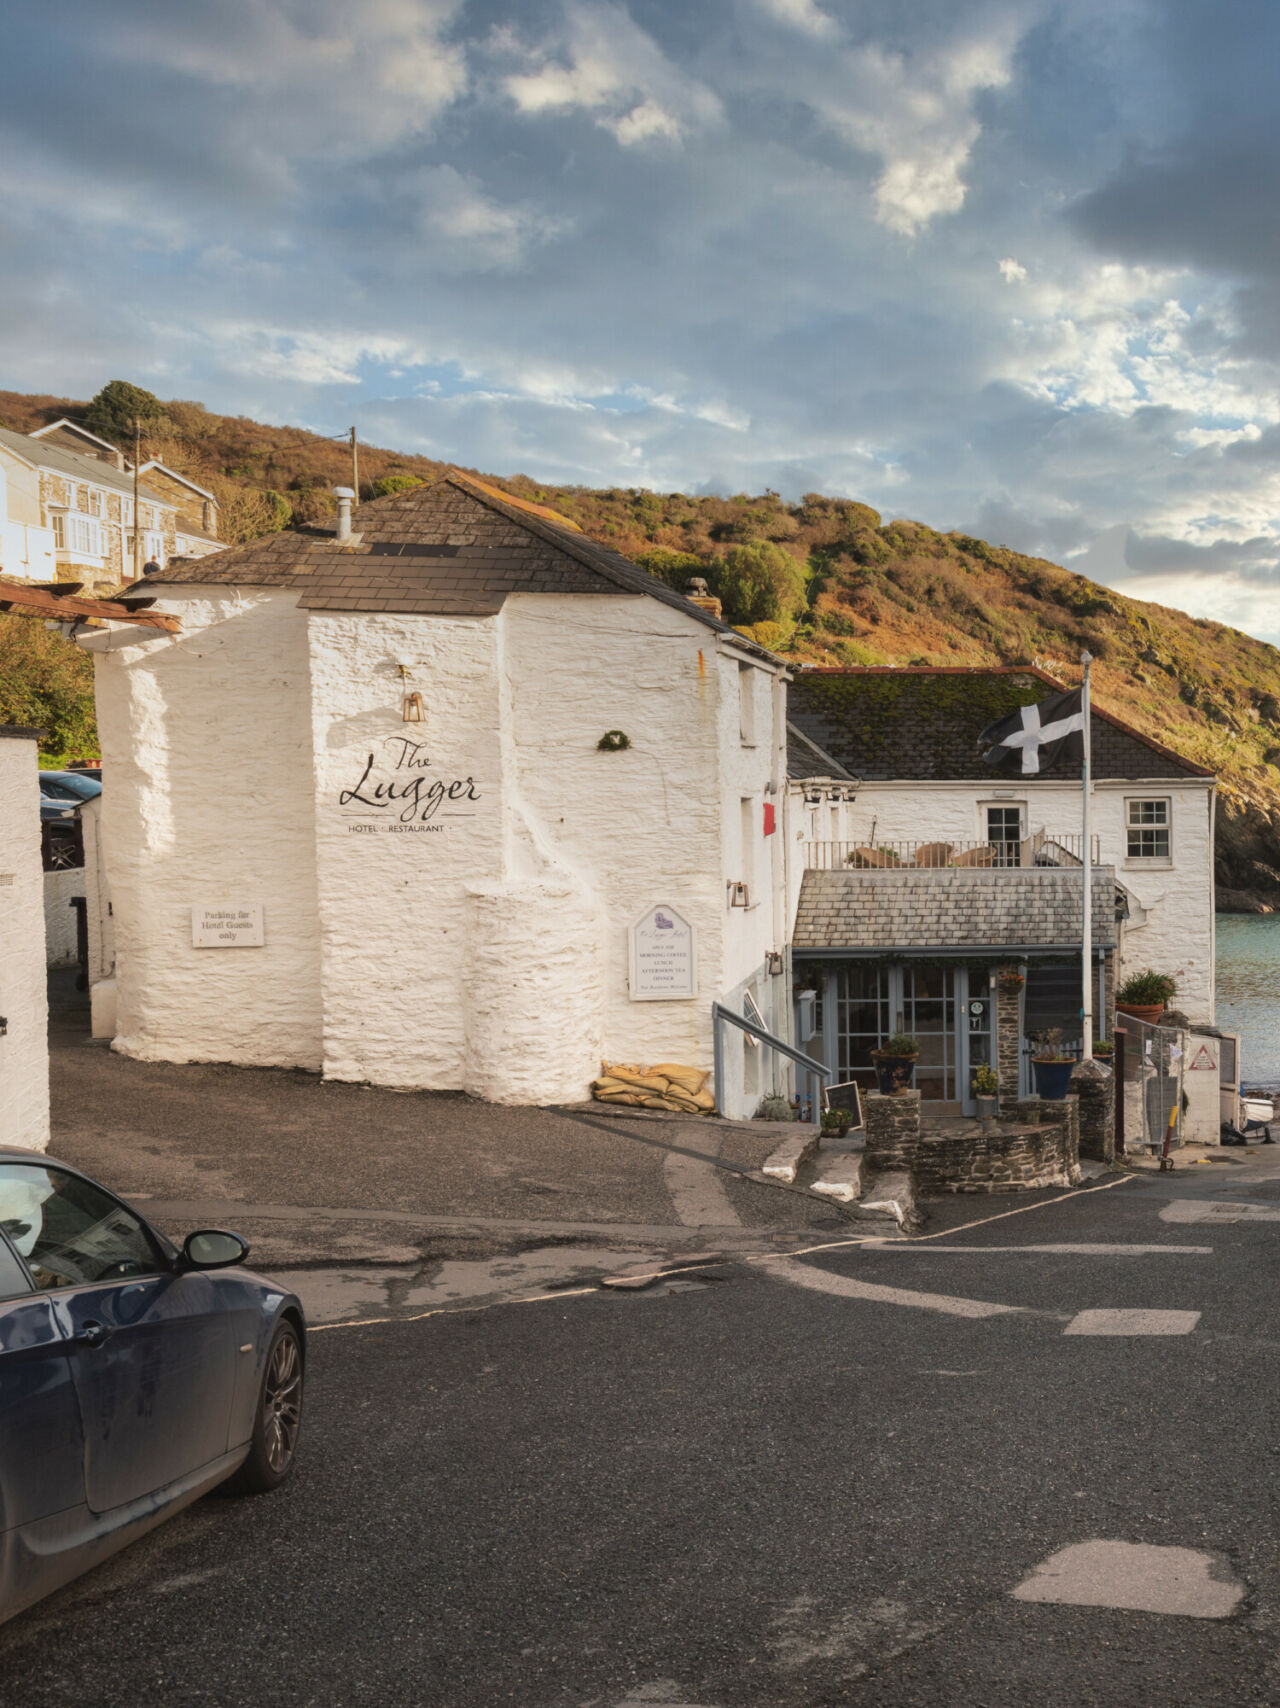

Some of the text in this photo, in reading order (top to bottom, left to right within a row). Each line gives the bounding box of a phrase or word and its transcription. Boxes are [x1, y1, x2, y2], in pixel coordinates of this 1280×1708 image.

[383, 736, 432, 769] The
[339, 753, 482, 822] Lugger
[348, 825, 445, 833] HOTEL RESTAURANT
[205, 910, 249, 920] Parking for
[201, 921, 224, 929] Hotel
[218, 931, 237, 940] only
